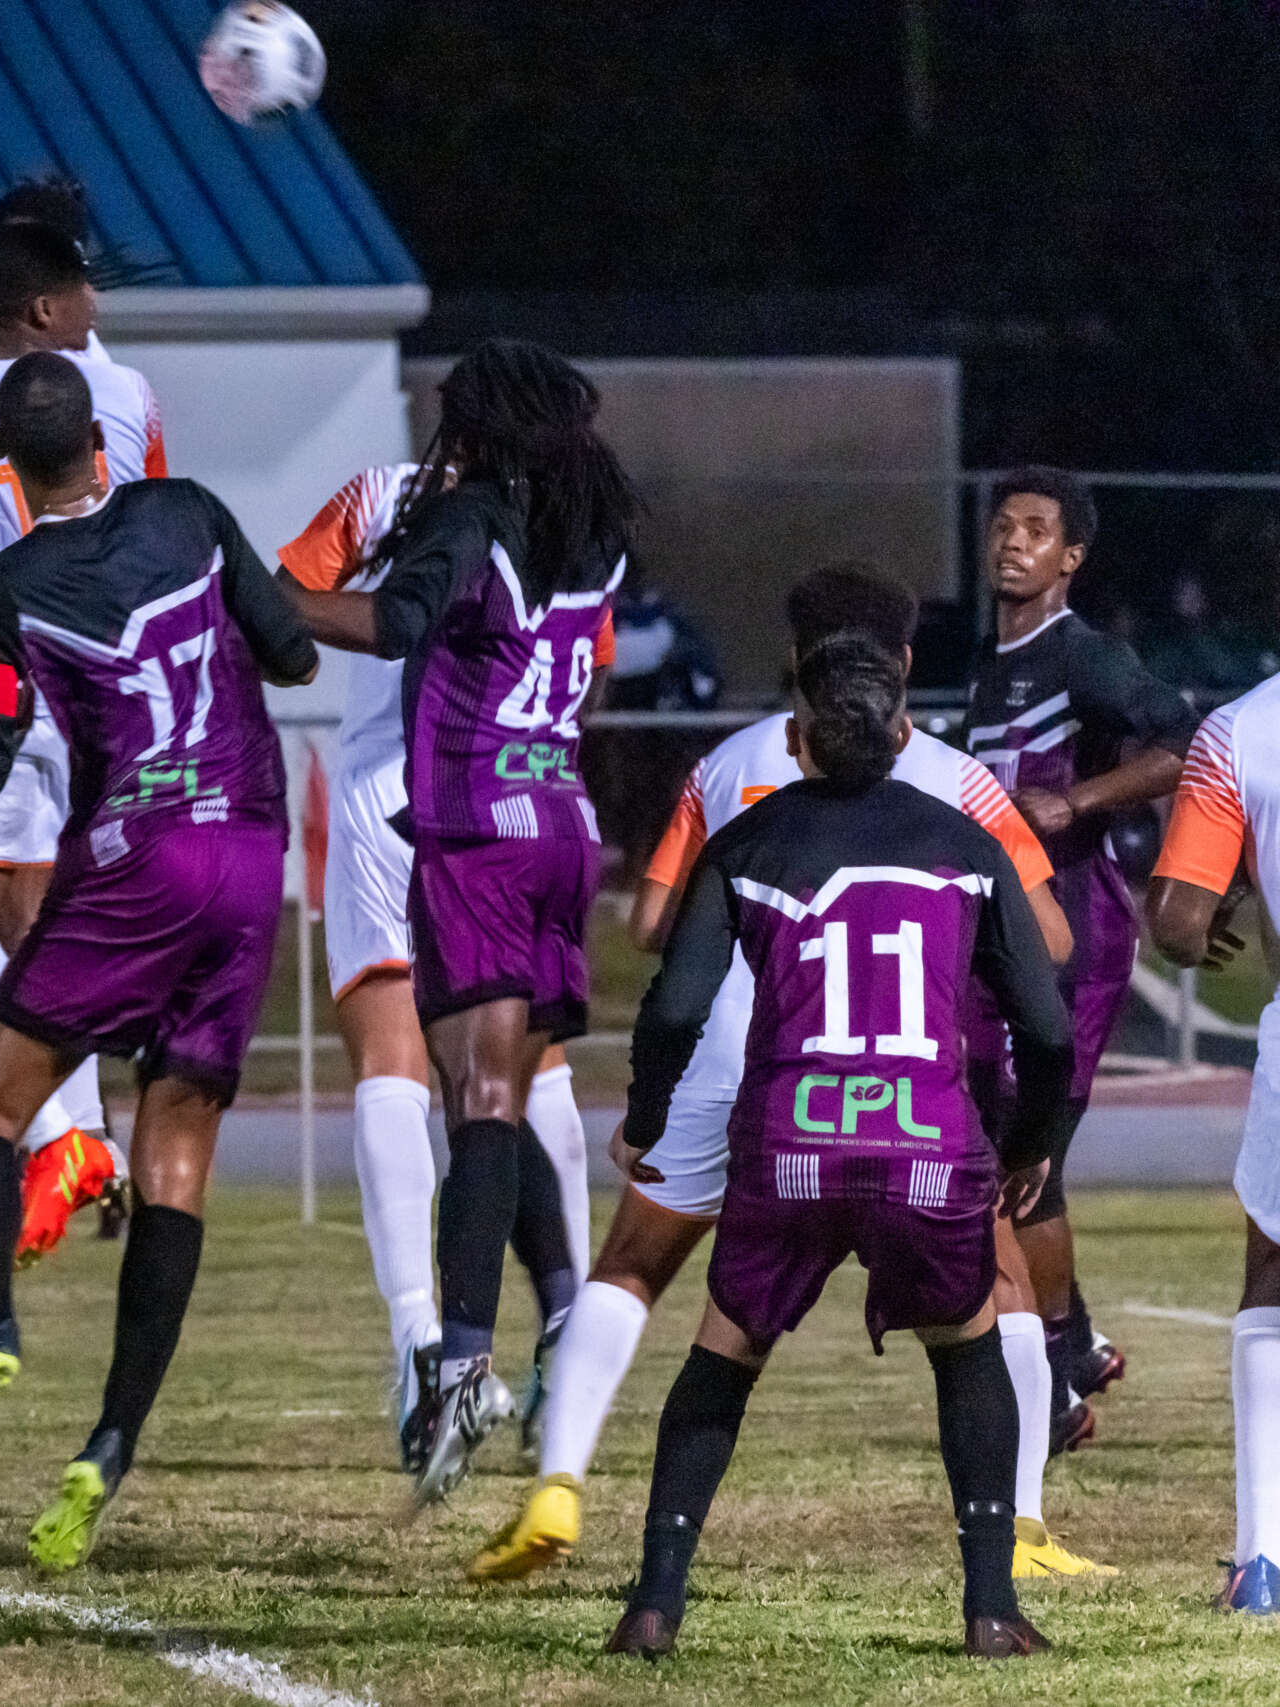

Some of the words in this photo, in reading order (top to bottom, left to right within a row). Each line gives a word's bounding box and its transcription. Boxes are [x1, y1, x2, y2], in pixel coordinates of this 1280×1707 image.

[117, 627, 216, 761] 17
[495, 637, 593, 738] 42
[495, 742, 576, 781] CPL
[799, 920, 938, 1060] 11
[793, 1074, 941, 1139] CPL
